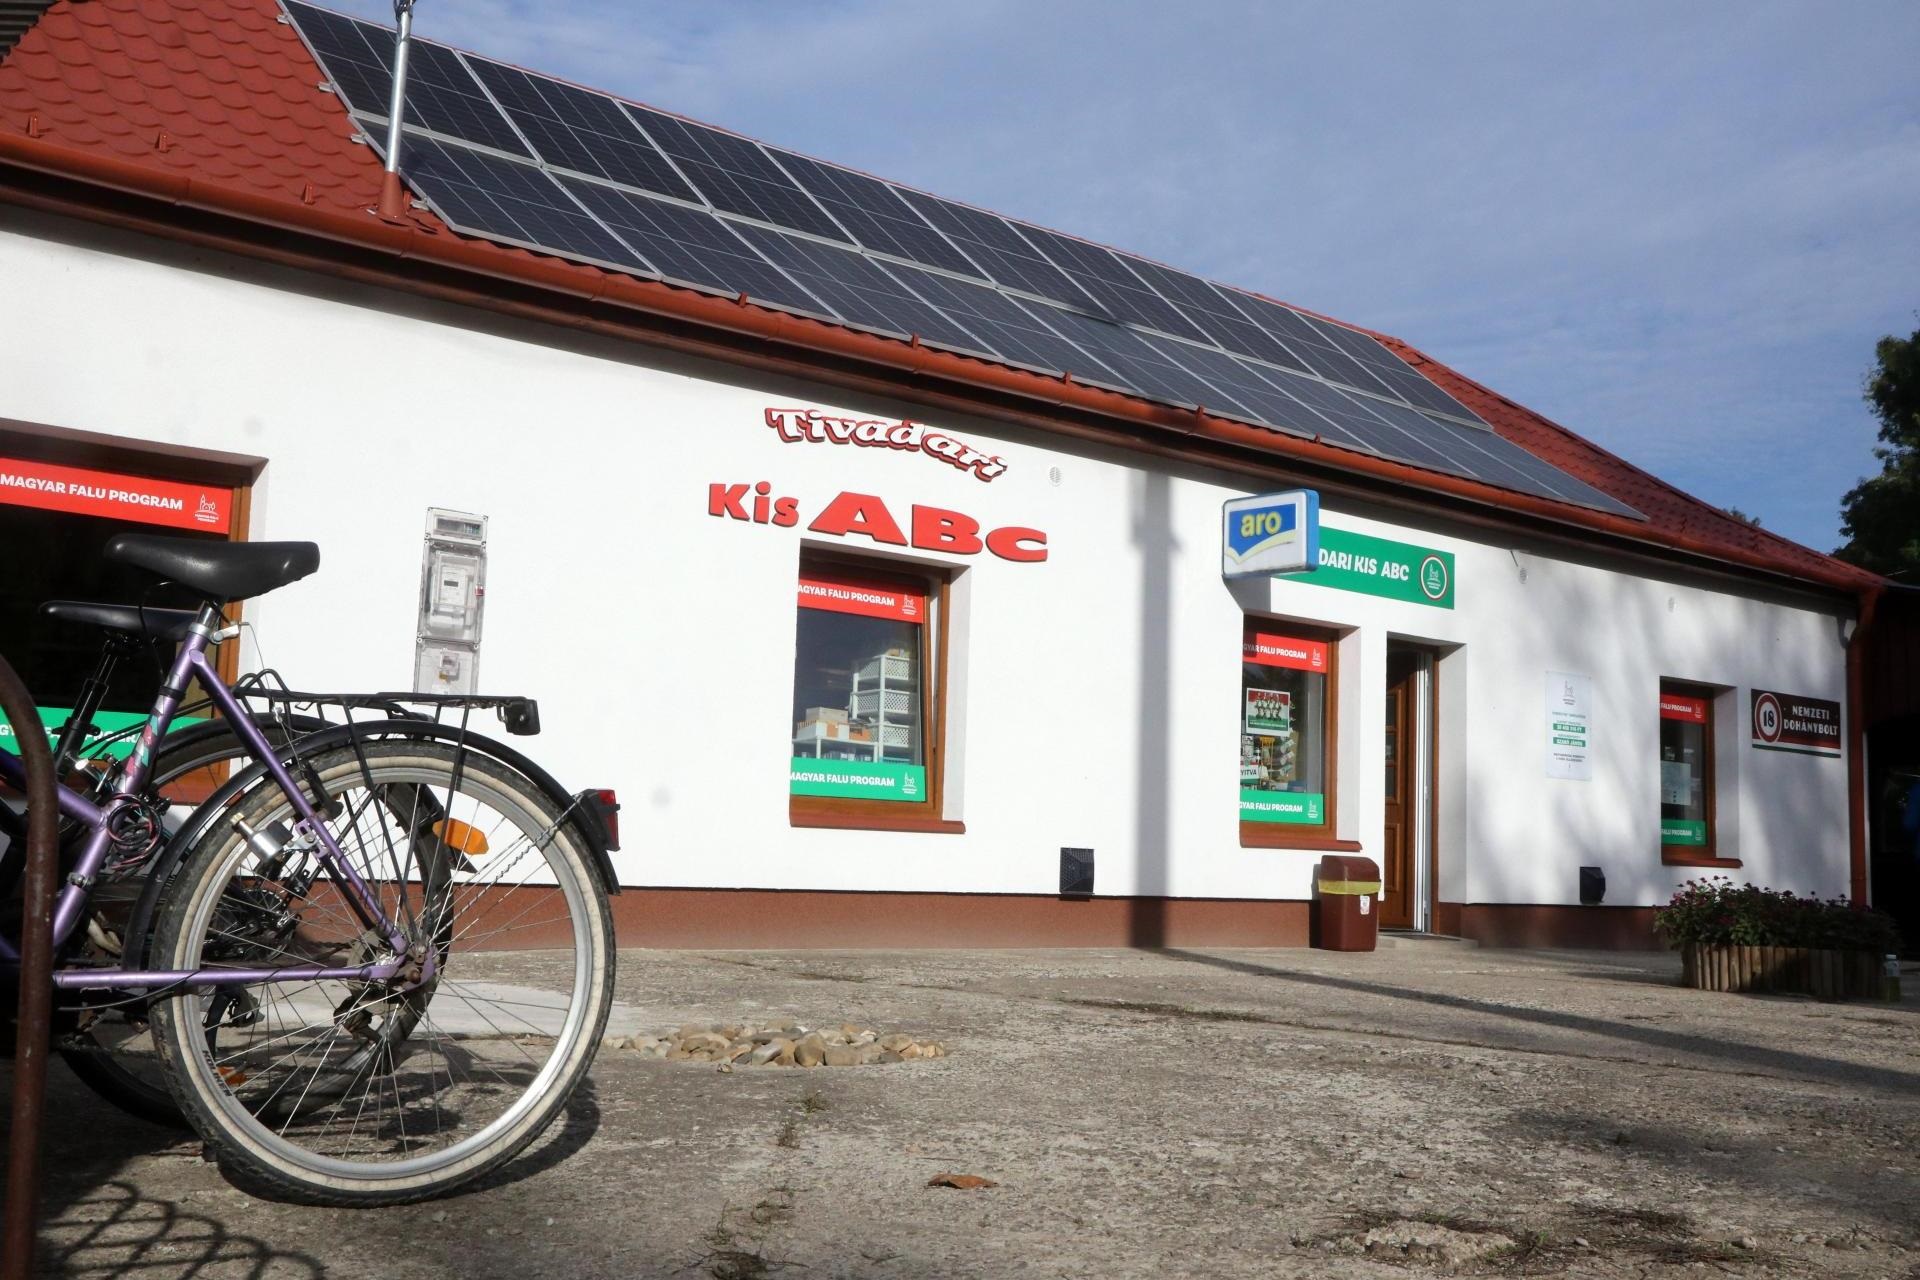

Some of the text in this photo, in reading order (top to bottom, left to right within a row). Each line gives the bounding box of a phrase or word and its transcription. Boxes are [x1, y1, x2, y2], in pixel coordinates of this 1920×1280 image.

[764, 406, 1008, 482] Tivadari
[0, 473, 183, 511] MAGYAR FALU PROGRAM
[708, 481, 1048, 562] Kis ABC
[1241, 511, 1282, 537] aro
[1318, 548, 1410, 581] DARI KIS ABC
[797, 584, 895, 607] AGYAR FALU PROGRAM
[1243, 643, 1307, 660] GYAR FALU PROGRAM
[1763, 710, 1775, 728] 18
[1792, 705, 1830, 720] NEMZETI
[1783, 718, 1839, 736] DOHÁNYBOLT
[826, 774, 849, 784] FALU
[850, 775, 895, 787] PROGRAM
[1240, 768, 1258, 776] YITVA
[1239, 801, 1303, 813] GYAR FALU PROGRAM
